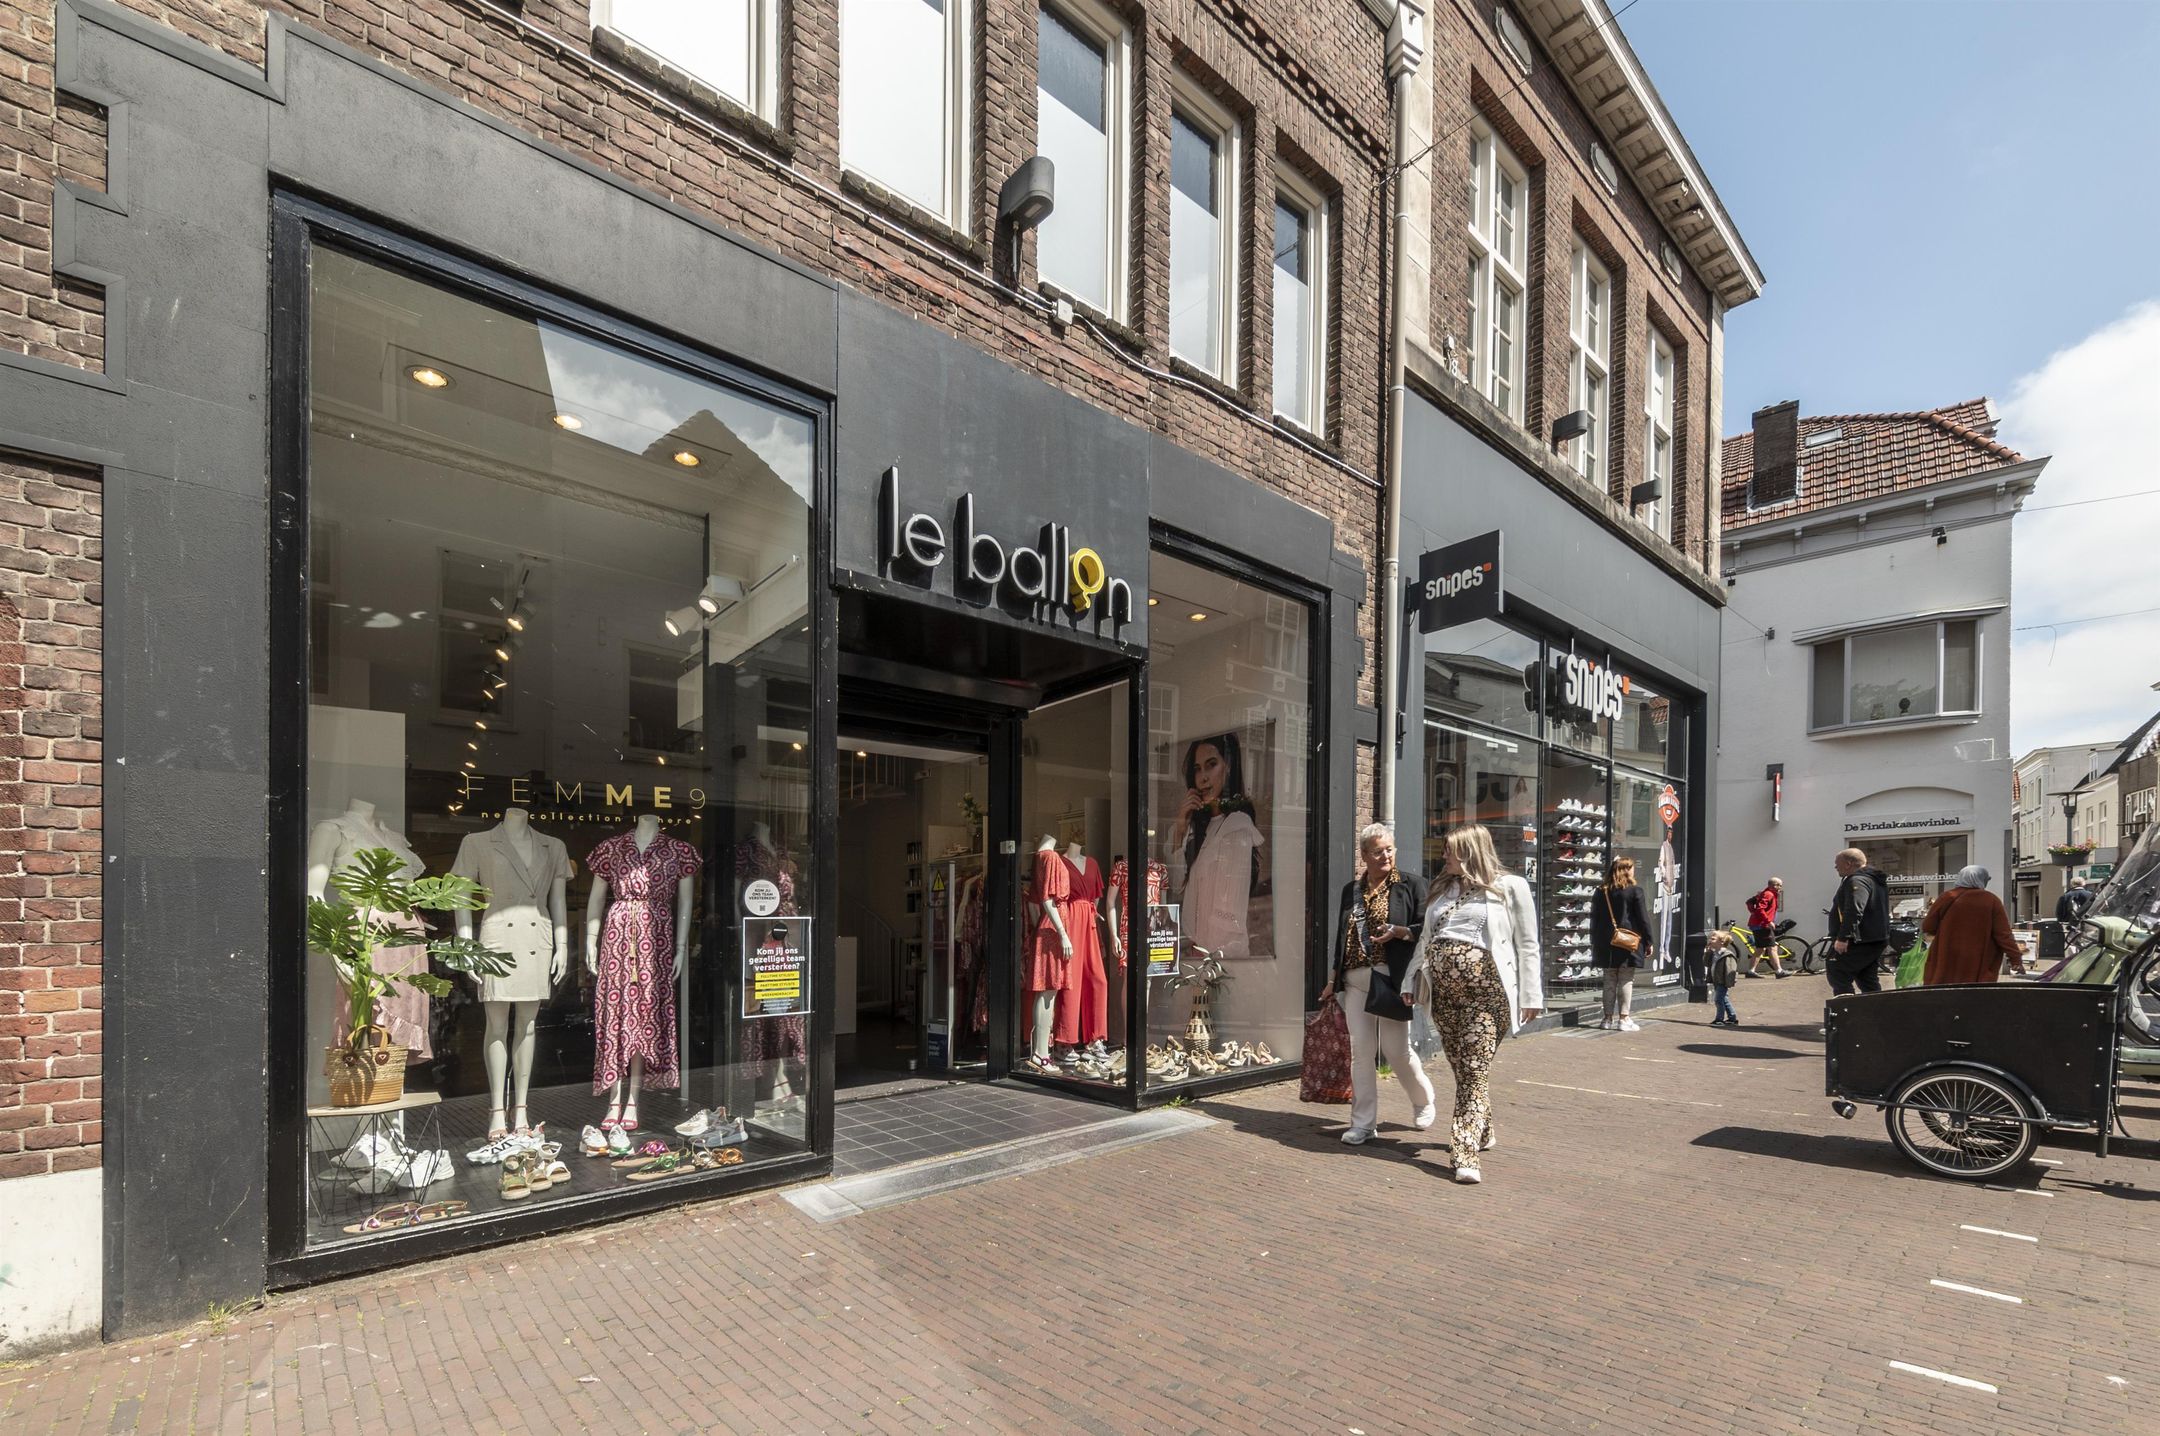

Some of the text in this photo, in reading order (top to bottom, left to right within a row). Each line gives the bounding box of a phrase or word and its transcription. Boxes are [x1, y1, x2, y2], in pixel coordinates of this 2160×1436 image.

[882, 465, 1132, 624] le ballon
[529, 811, 622, 824] collection
[657, 815, 692, 826] here
[1844, 817, 1961, 832] De Pindakaaswinkel
[1886, 872, 1958, 882] dakaaswinke
[775, 947, 784, 956] jij
[749, 956, 785, 965] gezellige
[754, 962, 800, 971] versterken?
